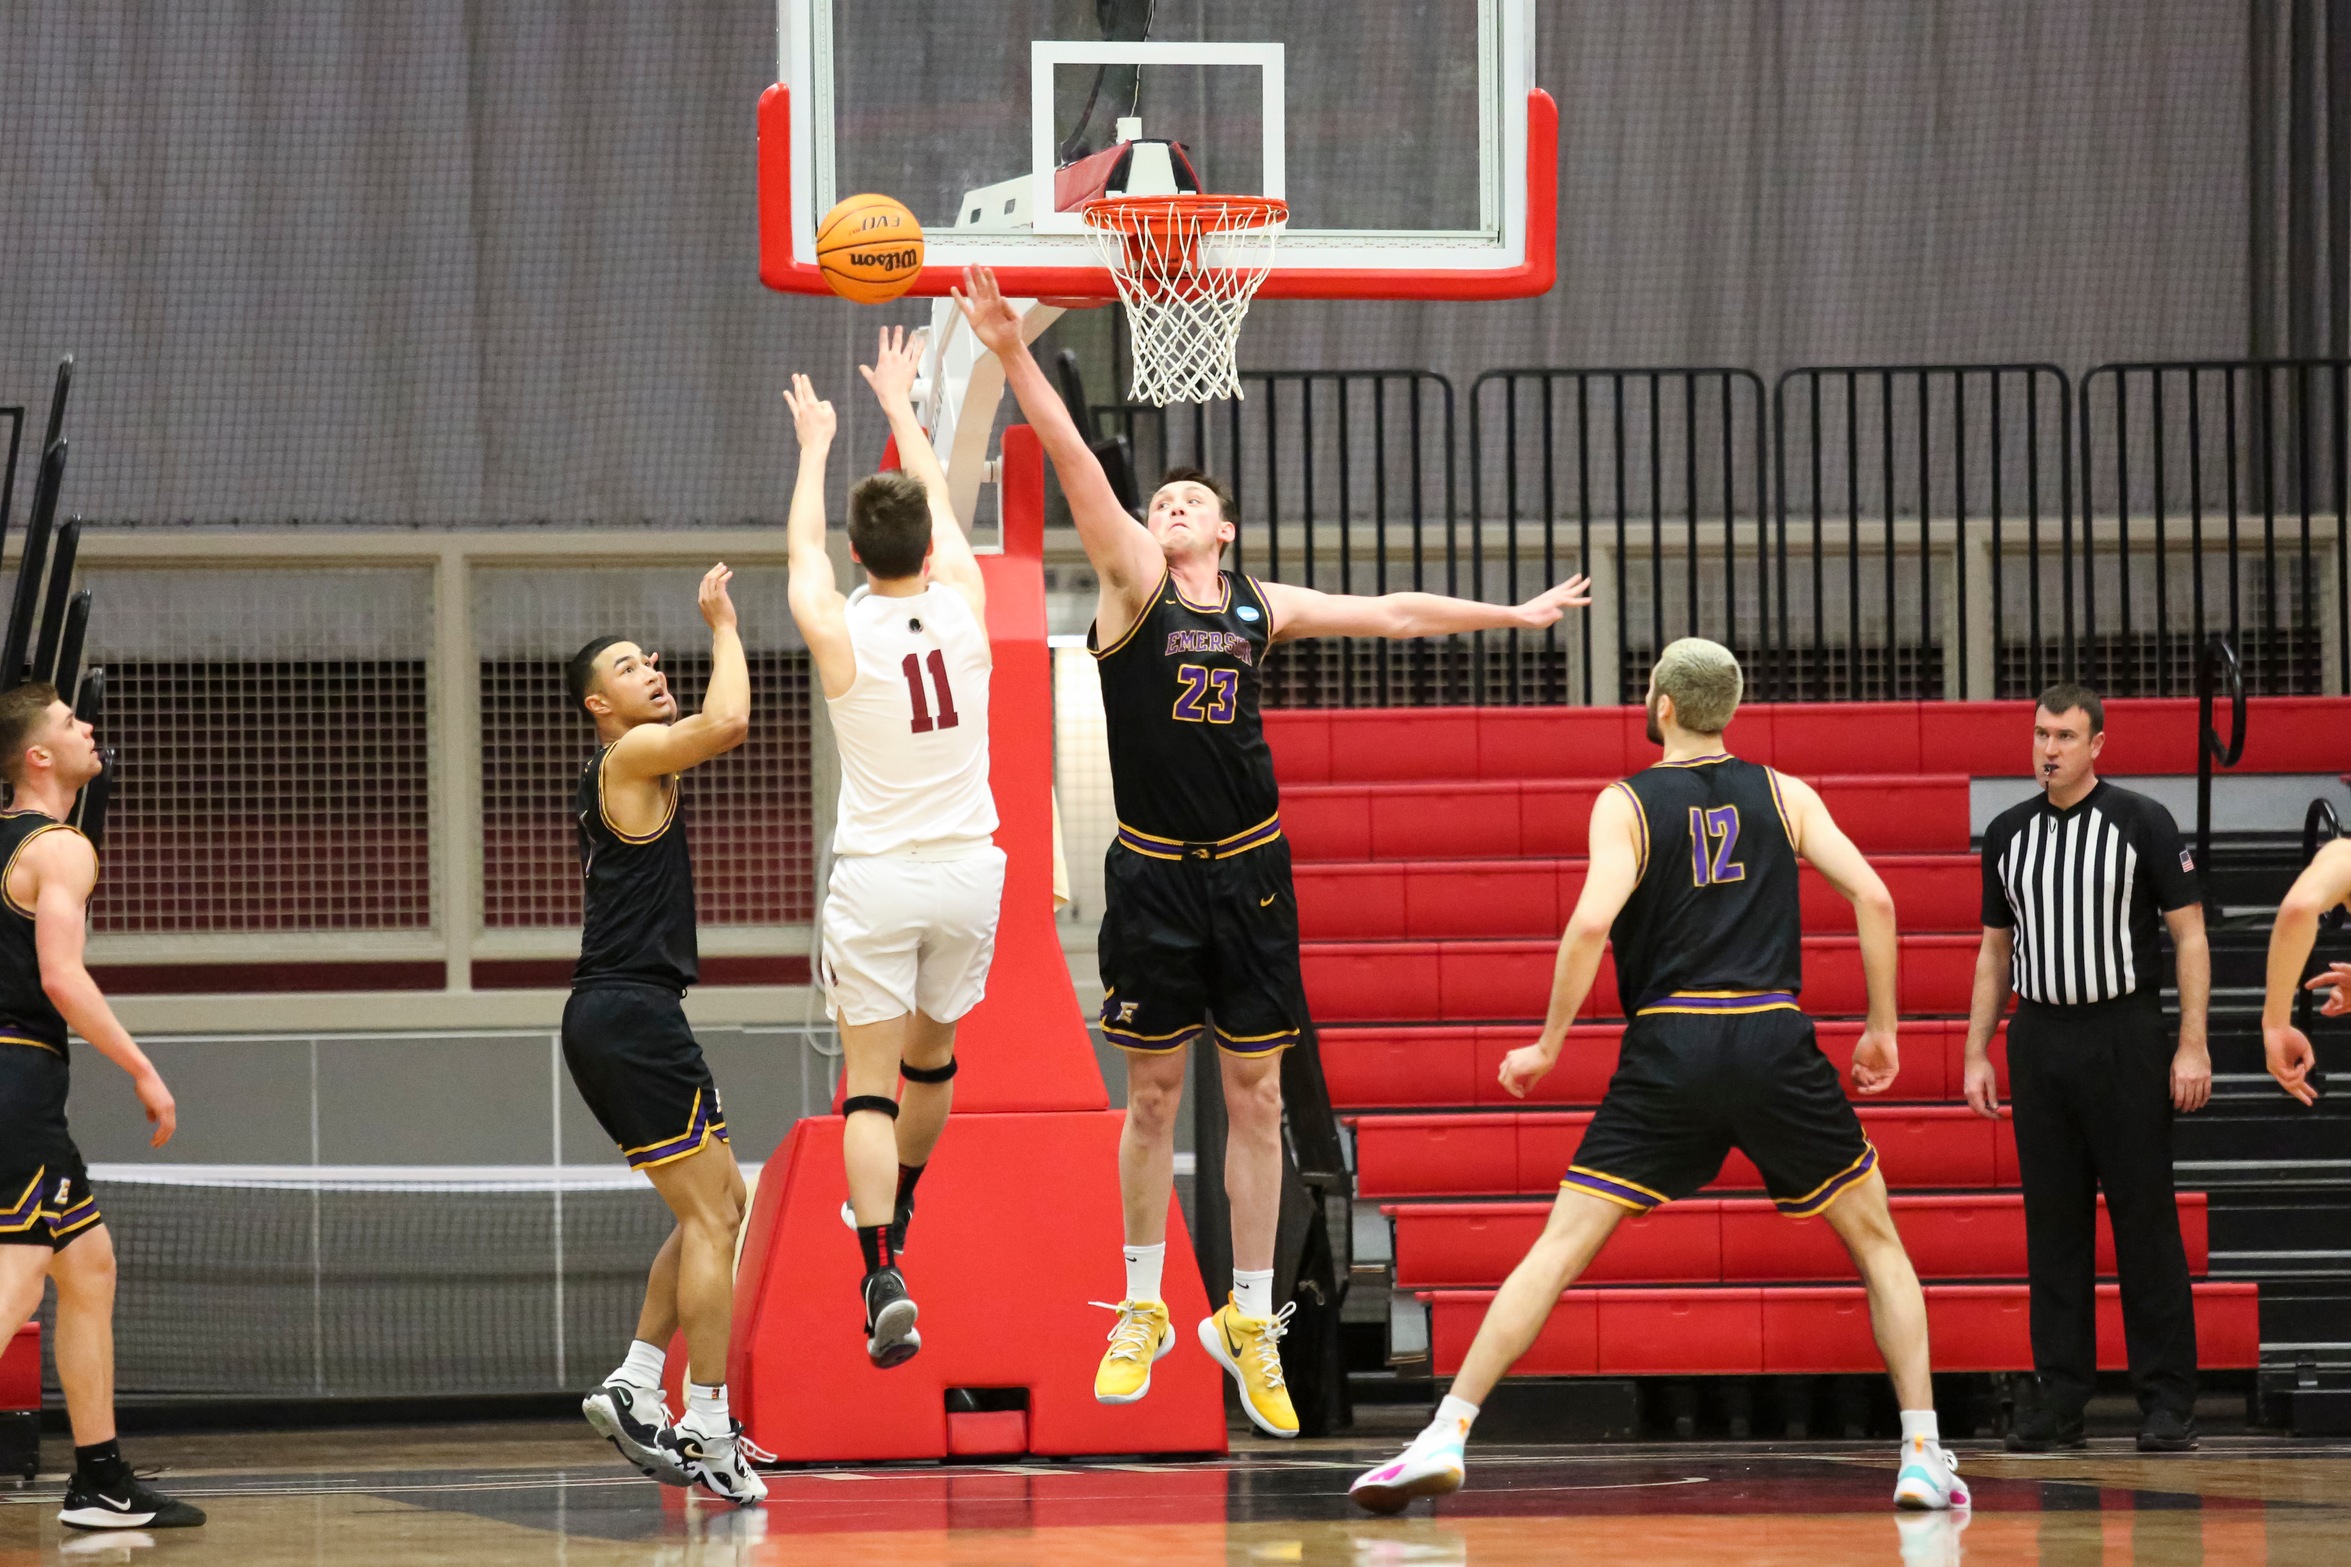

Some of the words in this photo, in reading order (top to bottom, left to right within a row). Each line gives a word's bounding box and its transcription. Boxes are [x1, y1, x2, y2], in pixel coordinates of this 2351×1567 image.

[850, 248, 917, 272] Wilson
[901, 648, 959, 734] 11
[1172, 663, 1239, 725] 23
[1689, 804, 1745, 888] 12
